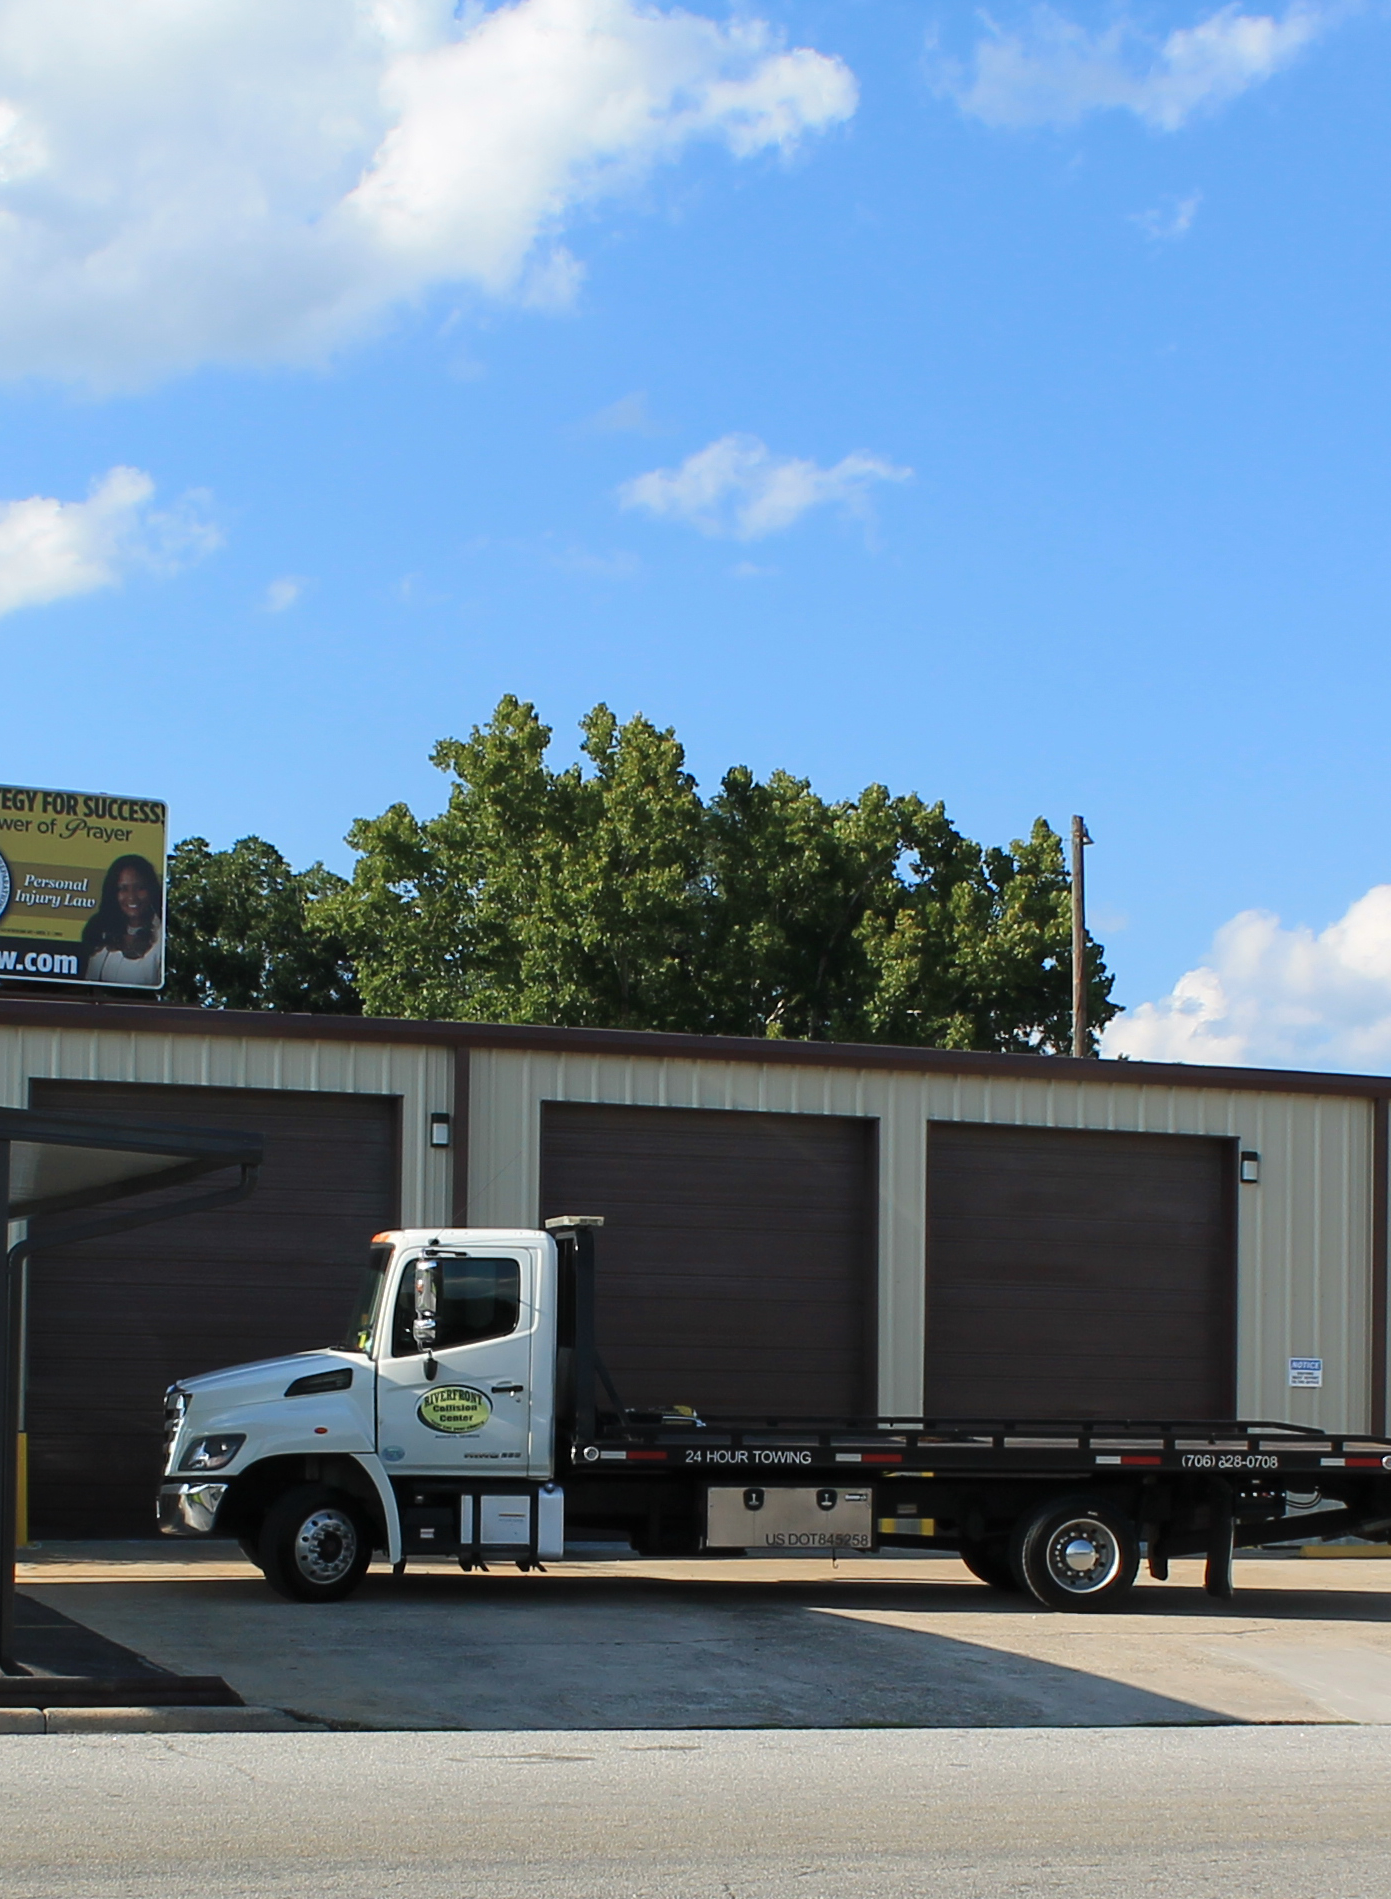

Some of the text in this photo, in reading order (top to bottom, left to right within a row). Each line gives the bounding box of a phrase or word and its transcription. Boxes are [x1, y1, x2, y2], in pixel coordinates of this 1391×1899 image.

[42, 792, 79, 817] FOR
[37, 818, 58, 834] of
[59, 818, 133, 843] Prayer
[24, 874, 89, 892] Personal
[15, 889, 96, 908] Injury Law
[424, 1389, 483, 1408] RIVERFRONT
[433, 1404, 478, 1413] Collision
[439, 1414, 474, 1423] Center
[685, 1450, 812, 1464] 24 HOUR TOWING
[1181, 1454, 1278, 1469] (706) 828-0708
[765, 1533, 785, 1546] US
